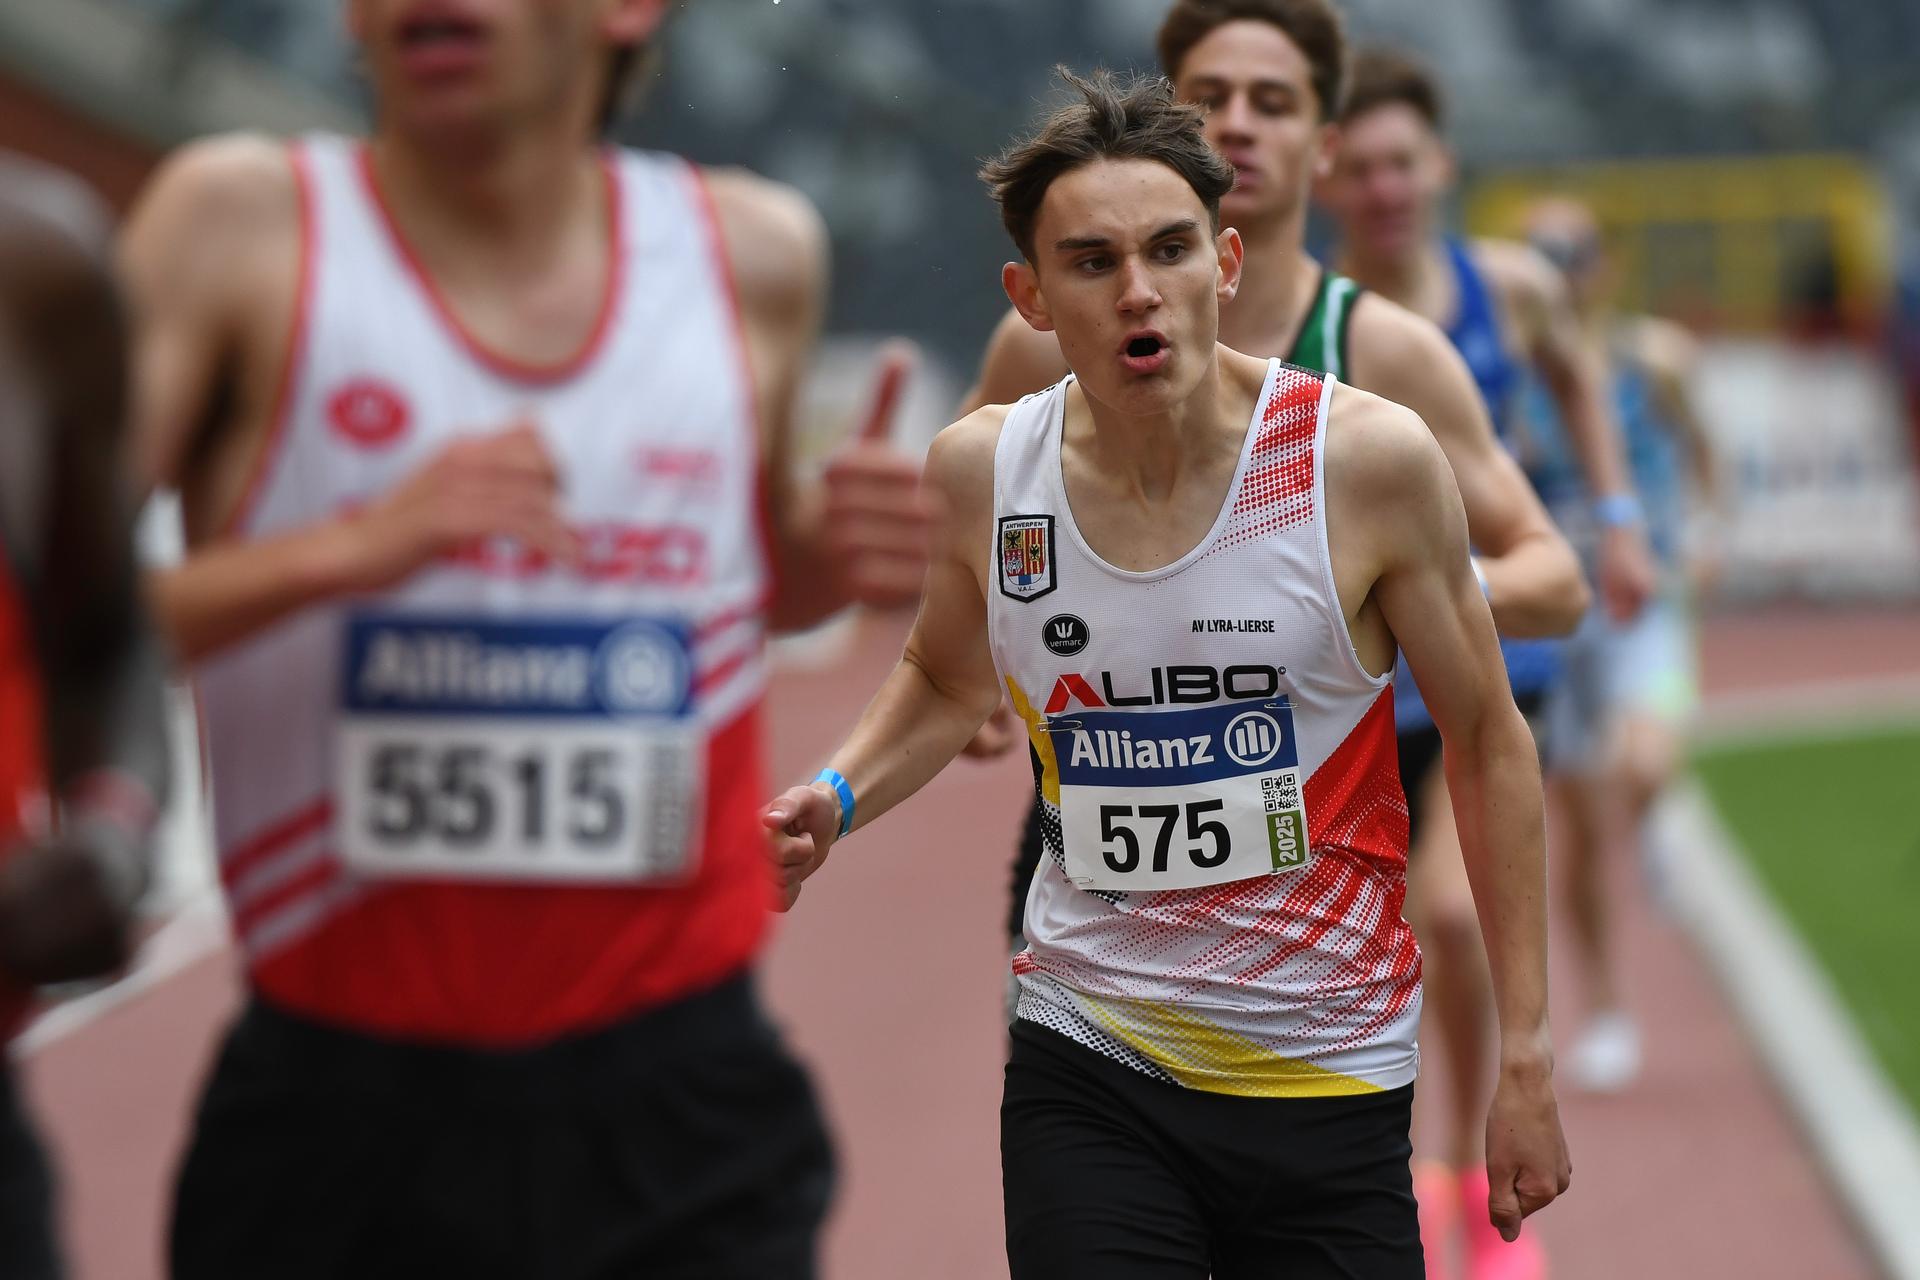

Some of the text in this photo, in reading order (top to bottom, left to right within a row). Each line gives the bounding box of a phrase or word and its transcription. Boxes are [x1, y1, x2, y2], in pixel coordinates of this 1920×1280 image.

[1005, 521, 1043, 530] ANTWERPEN
[1050, 638, 1082, 648] vermarc
[1192, 619, 1275, 633] AV LYRA-LIERSE
[1070, 729, 1214, 769] Allianz
[369, 742, 626, 846] 5515
[1100, 798, 1232, 873] 575
[1277, 815, 1298, 862] 2025
